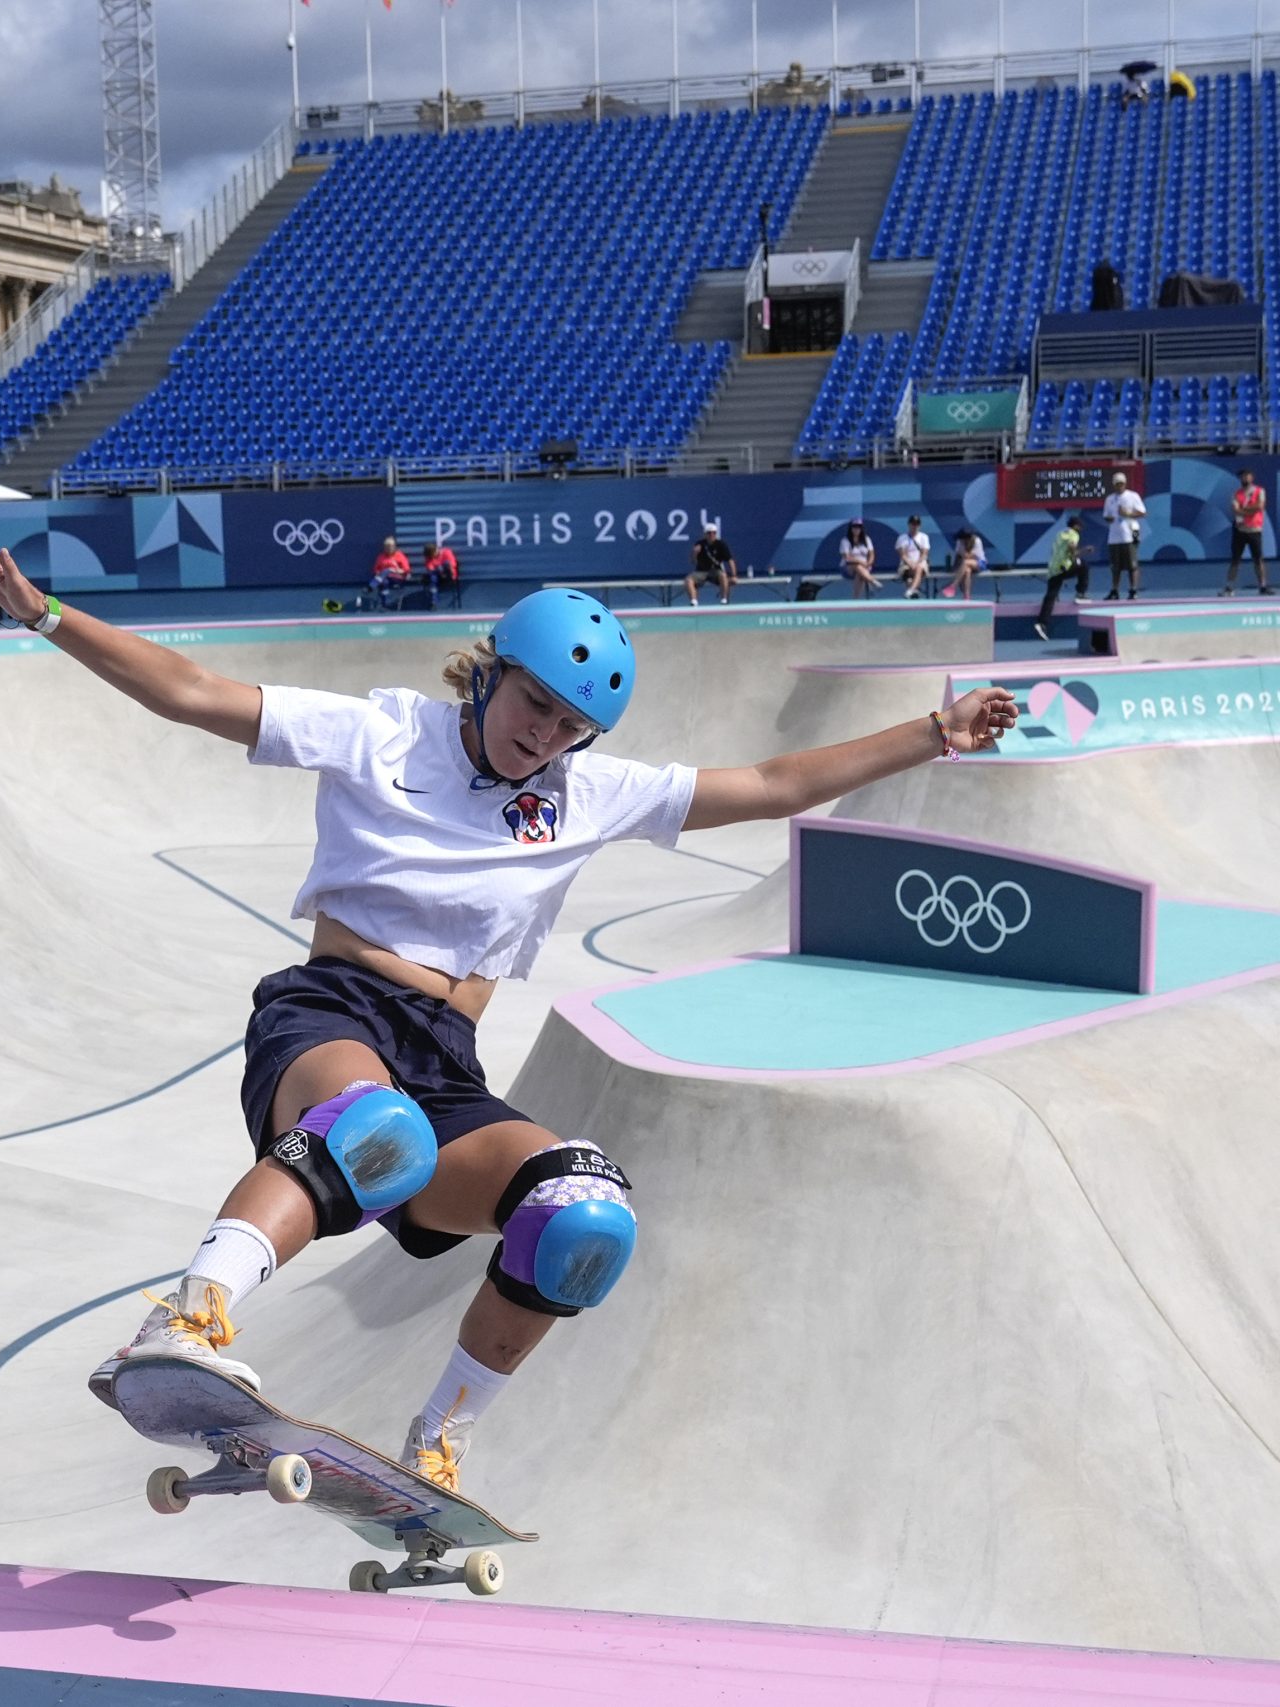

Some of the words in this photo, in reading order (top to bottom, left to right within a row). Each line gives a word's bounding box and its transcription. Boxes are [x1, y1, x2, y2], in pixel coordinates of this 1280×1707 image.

[434, 512, 572, 548] PARiS
[593, 508, 723, 543] 2024
[469, 623, 494, 634] PAR
[572, 1164, 604, 1174] KILLER
[574, 1151, 617, 1172] 187
